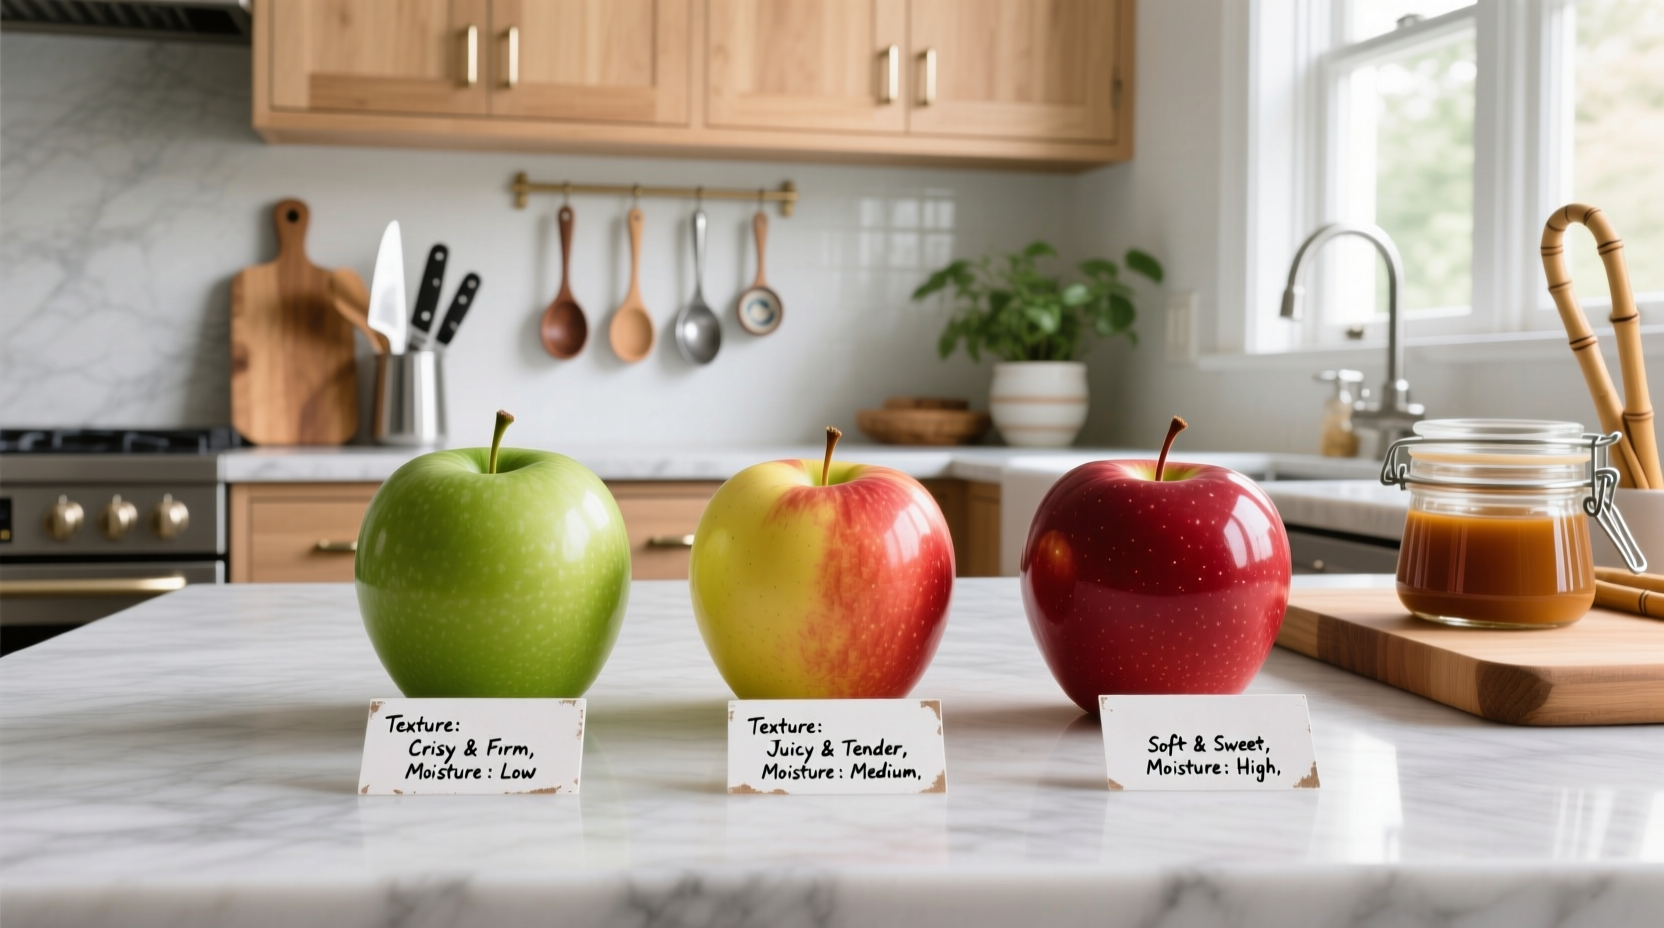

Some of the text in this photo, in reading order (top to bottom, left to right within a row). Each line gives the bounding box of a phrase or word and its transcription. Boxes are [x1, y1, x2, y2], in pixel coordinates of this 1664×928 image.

[385, 714, 460, 733] Texture:
[747, 716, 822, 735] Texture:
[408, 737, 534, 765] Crisy & Firm,
[766, 738, 907, 765] Juicy & Tender,
[1147, 733, 1270, 757] Soft & Sweet,
[500, 762, 537, 780] Low
[850, 761, 921, 780] Medium,
[1237, 757, 1281, 782] High,
